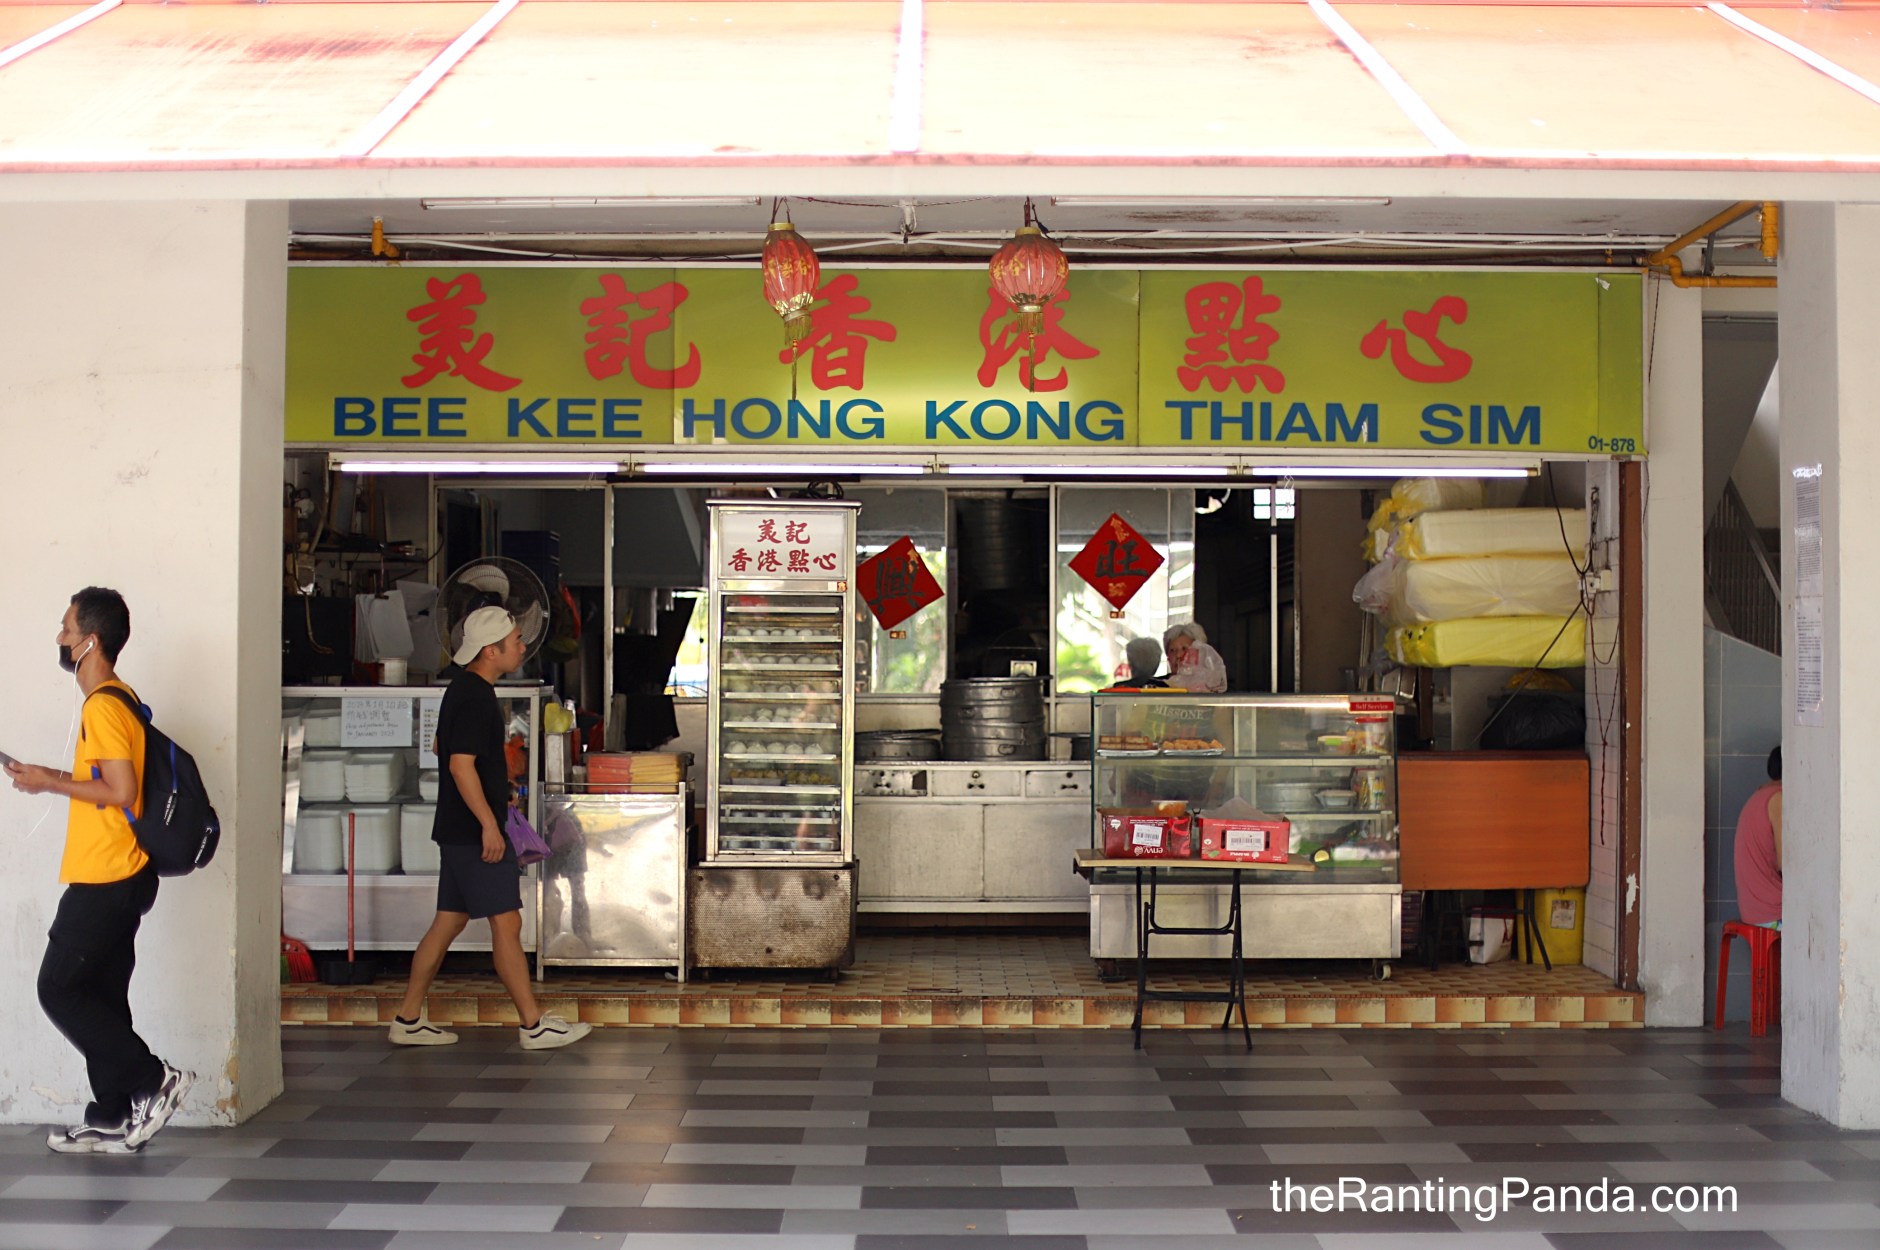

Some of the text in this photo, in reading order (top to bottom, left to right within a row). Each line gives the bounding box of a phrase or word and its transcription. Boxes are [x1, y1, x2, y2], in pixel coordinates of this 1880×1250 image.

[401, 272, 1473, 395] 美記香港點心
[333, 396, 1541, 446] BEE KEE HONG KONG THIAM SIM
[1588, 435, 1635, 452] 01-878
[757, 519, 811, 545] 美記
[728, 548, 837, 573] 香港點心
